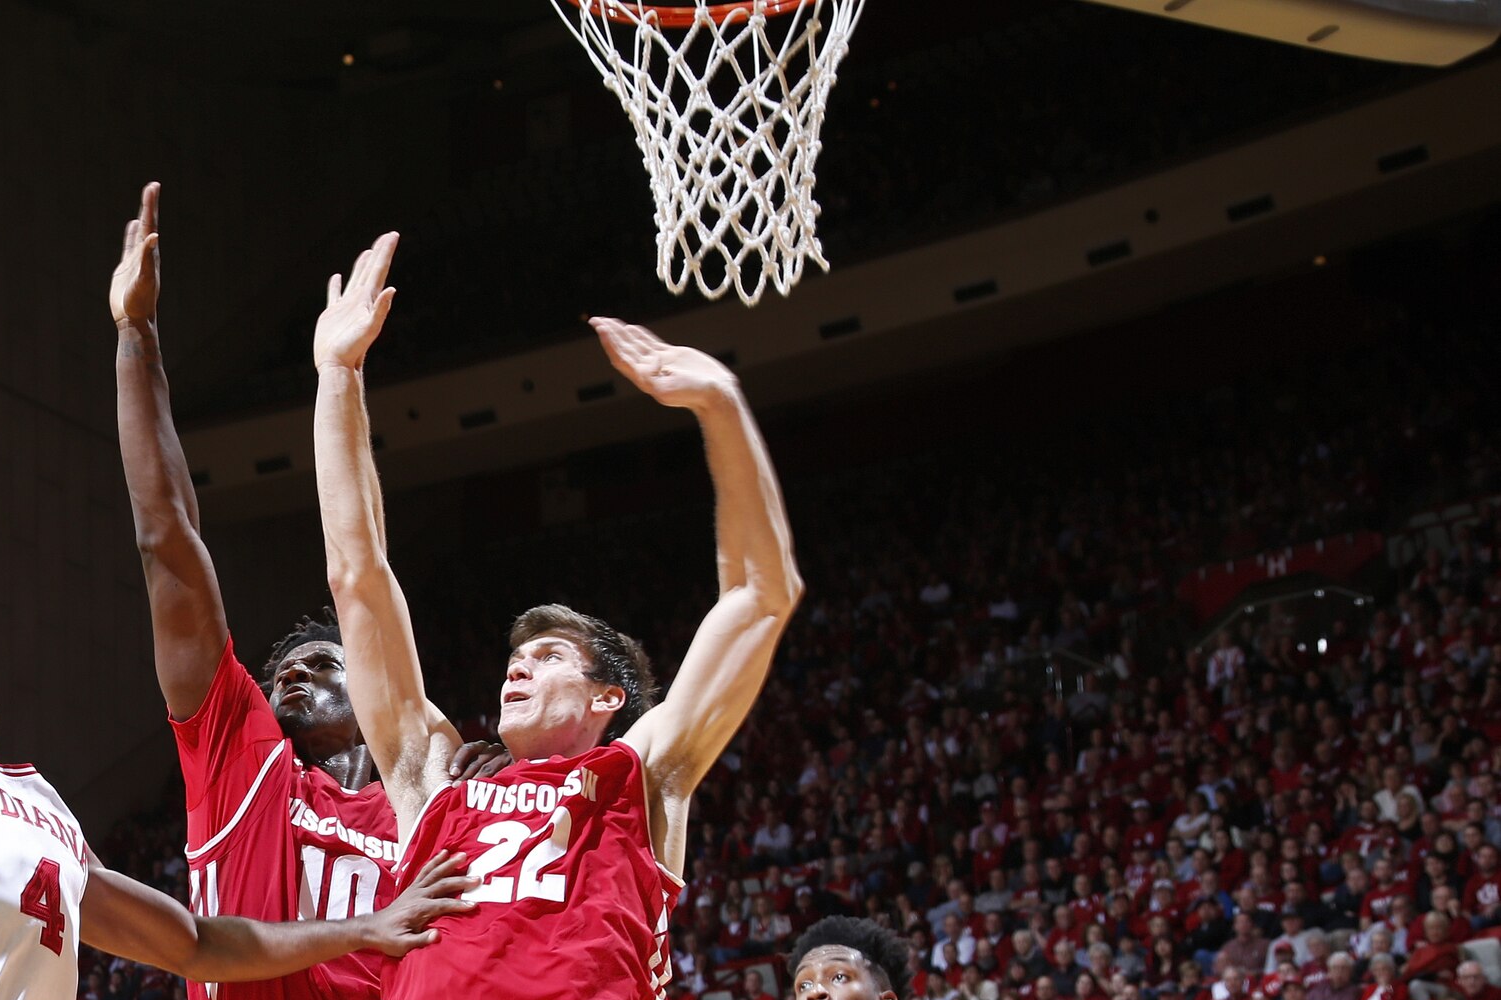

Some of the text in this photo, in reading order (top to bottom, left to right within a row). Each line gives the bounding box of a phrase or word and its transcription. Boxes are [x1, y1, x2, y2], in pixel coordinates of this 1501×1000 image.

[466, 766, 599, 815] WISCOSIN
[460, 805, 572, 904] 22
[19, 856, 65, 957] 4
